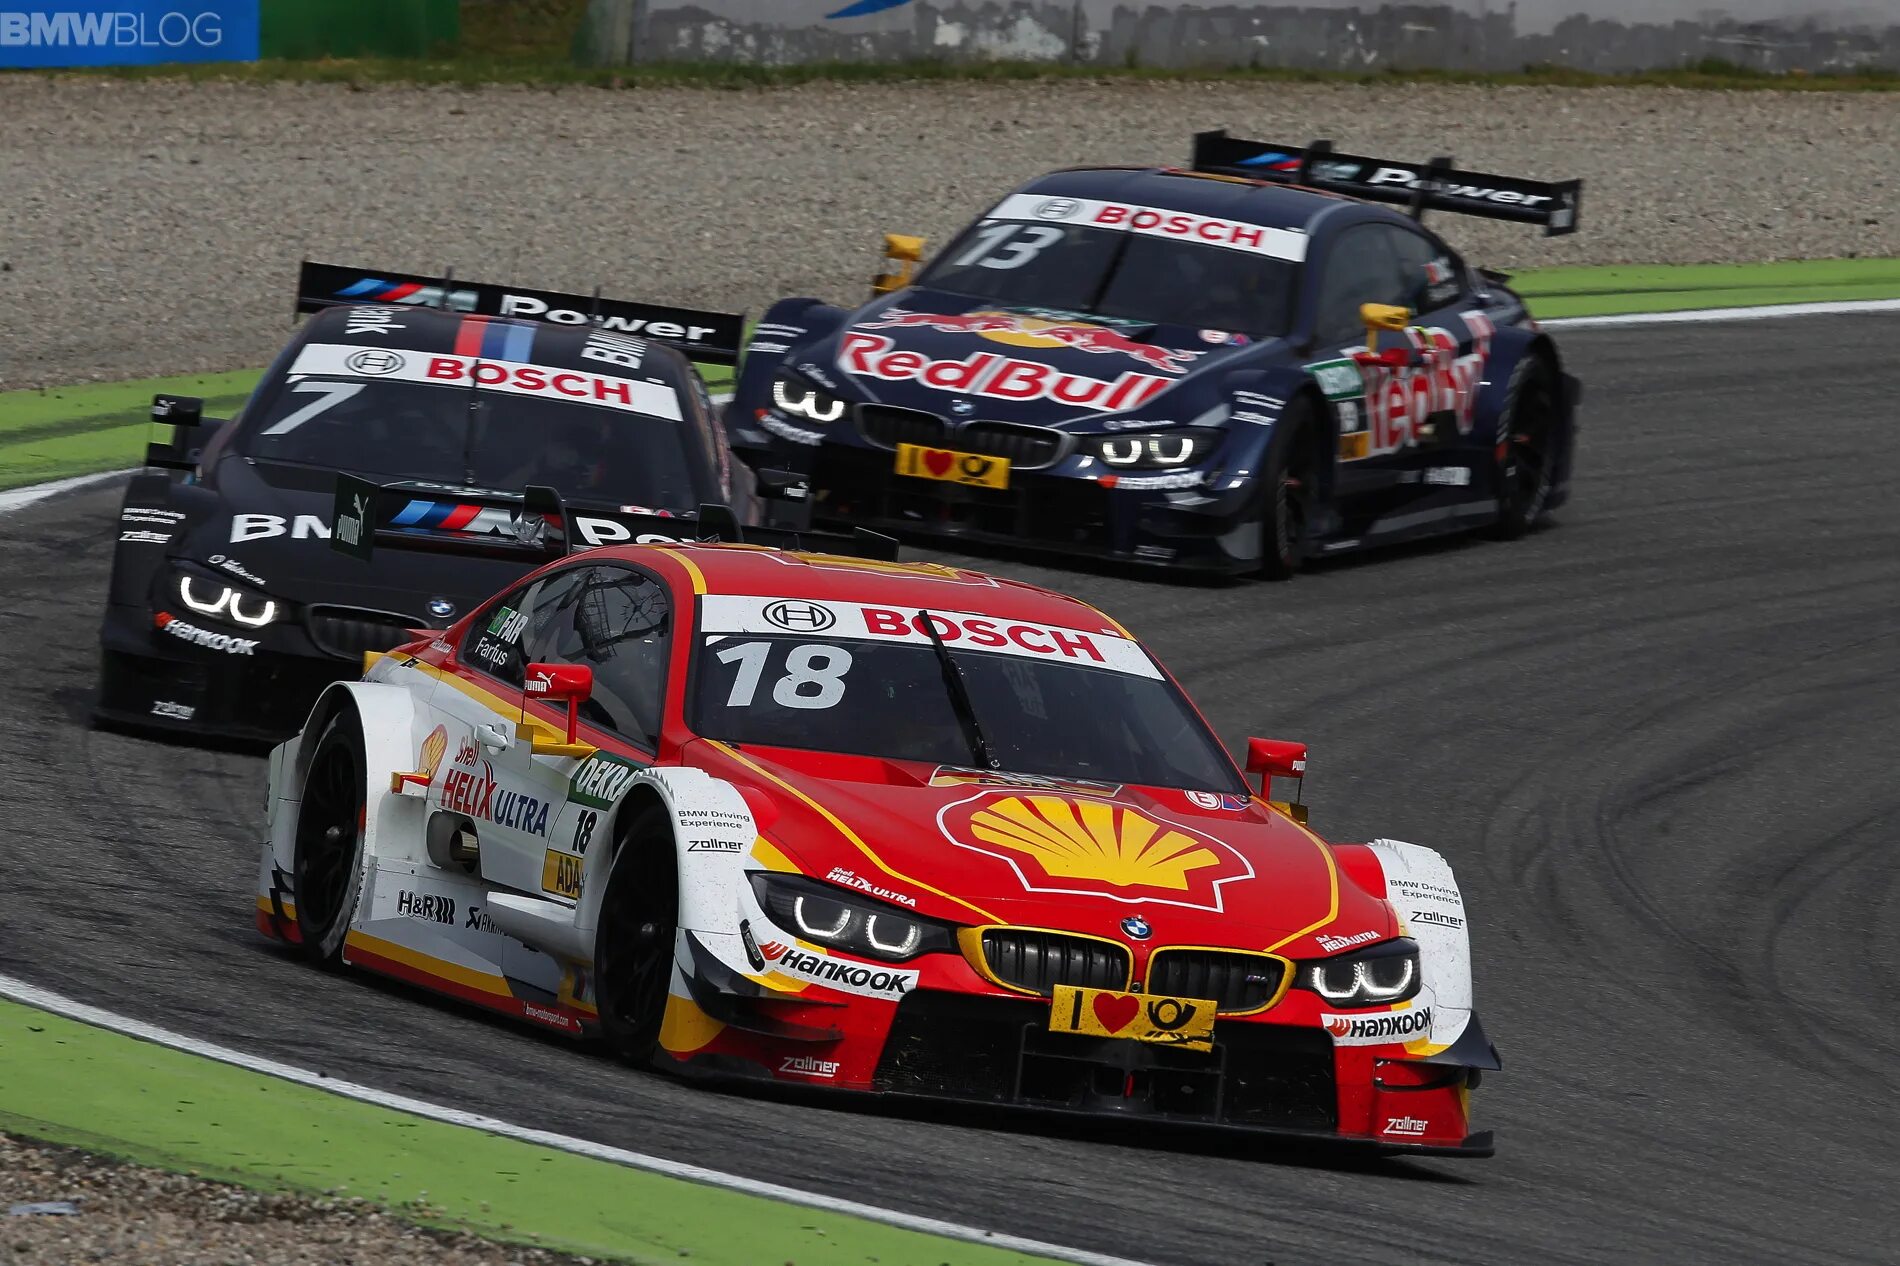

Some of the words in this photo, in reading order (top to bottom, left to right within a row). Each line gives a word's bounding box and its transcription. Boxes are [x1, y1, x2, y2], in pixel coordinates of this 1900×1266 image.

[1095, 206, 1264, 248] BOSCH
[953, 222, 1064, 270] 13
[501, 294, 716, 340] Power
[426, 357, 632, 405] BOSCH
[261, 382, 367, 434] 7
[497, 611, 529, 645] FAR
[860, 608, 1106, 663] BOSCH
[475, 637, 508, 666] Farfus
[524, 680, 547, 692] PUMA
[716, 642, 853, 709] 18
[455, 736, 480, 767] Shell
[575, 758, 642, 800] DEKRA
[441, 758, 498, 822] HELIX
[494, 789, 550, 838] ULTRA
[574, 809, 598, 854] 18
[678, 810, 709, 818] BMW
[711, 810, 750, 822] Driving
[680, 819, 743, 829] Experience
[687, 839, 743, 853] zollner
[832, 866, 855, 877] Shell
[826, 871, 873, 892] HELIX
[872, 886, 917, 908] ULTRA
[1389, 879, 1420, 889] BMW
[1421, 882, 1459, 897] Driving
[1402, 889, 1461, 906] Experience
[398, 890, 435, 919] H&R
[1410, 911, 1464, 929] zollner
[1321, 935, 1352, 952] HELIX
[1350, 930, 1381, 946] ULTRA
[779, 949, 912, 993] Hankook
[1350, 1007, 1432, 1038] Hankook
[779, 1056, 840, 1077] zollner
